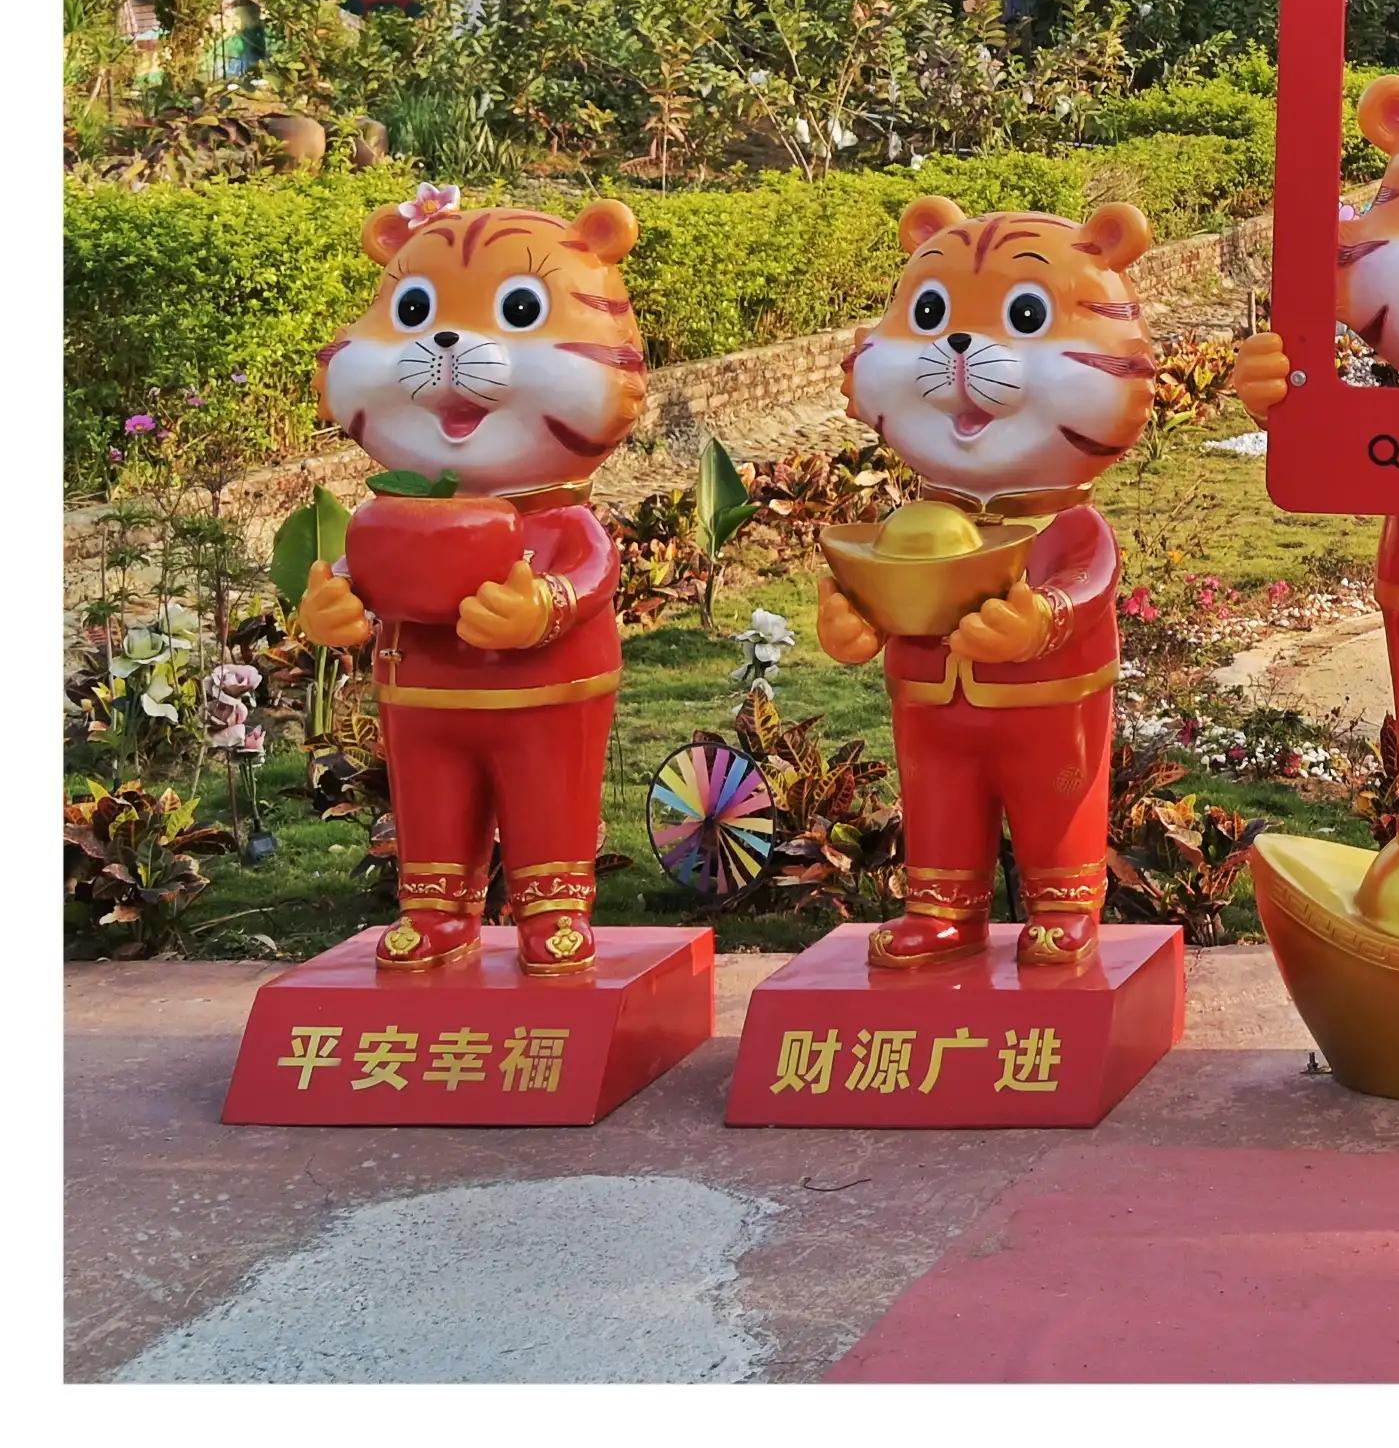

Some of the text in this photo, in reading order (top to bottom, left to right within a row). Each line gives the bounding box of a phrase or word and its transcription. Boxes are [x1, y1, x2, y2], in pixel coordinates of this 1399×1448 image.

[278, 1026, 570, 1092] 平安幸福
[769, 1027, 1062, 1094] 财源广进
